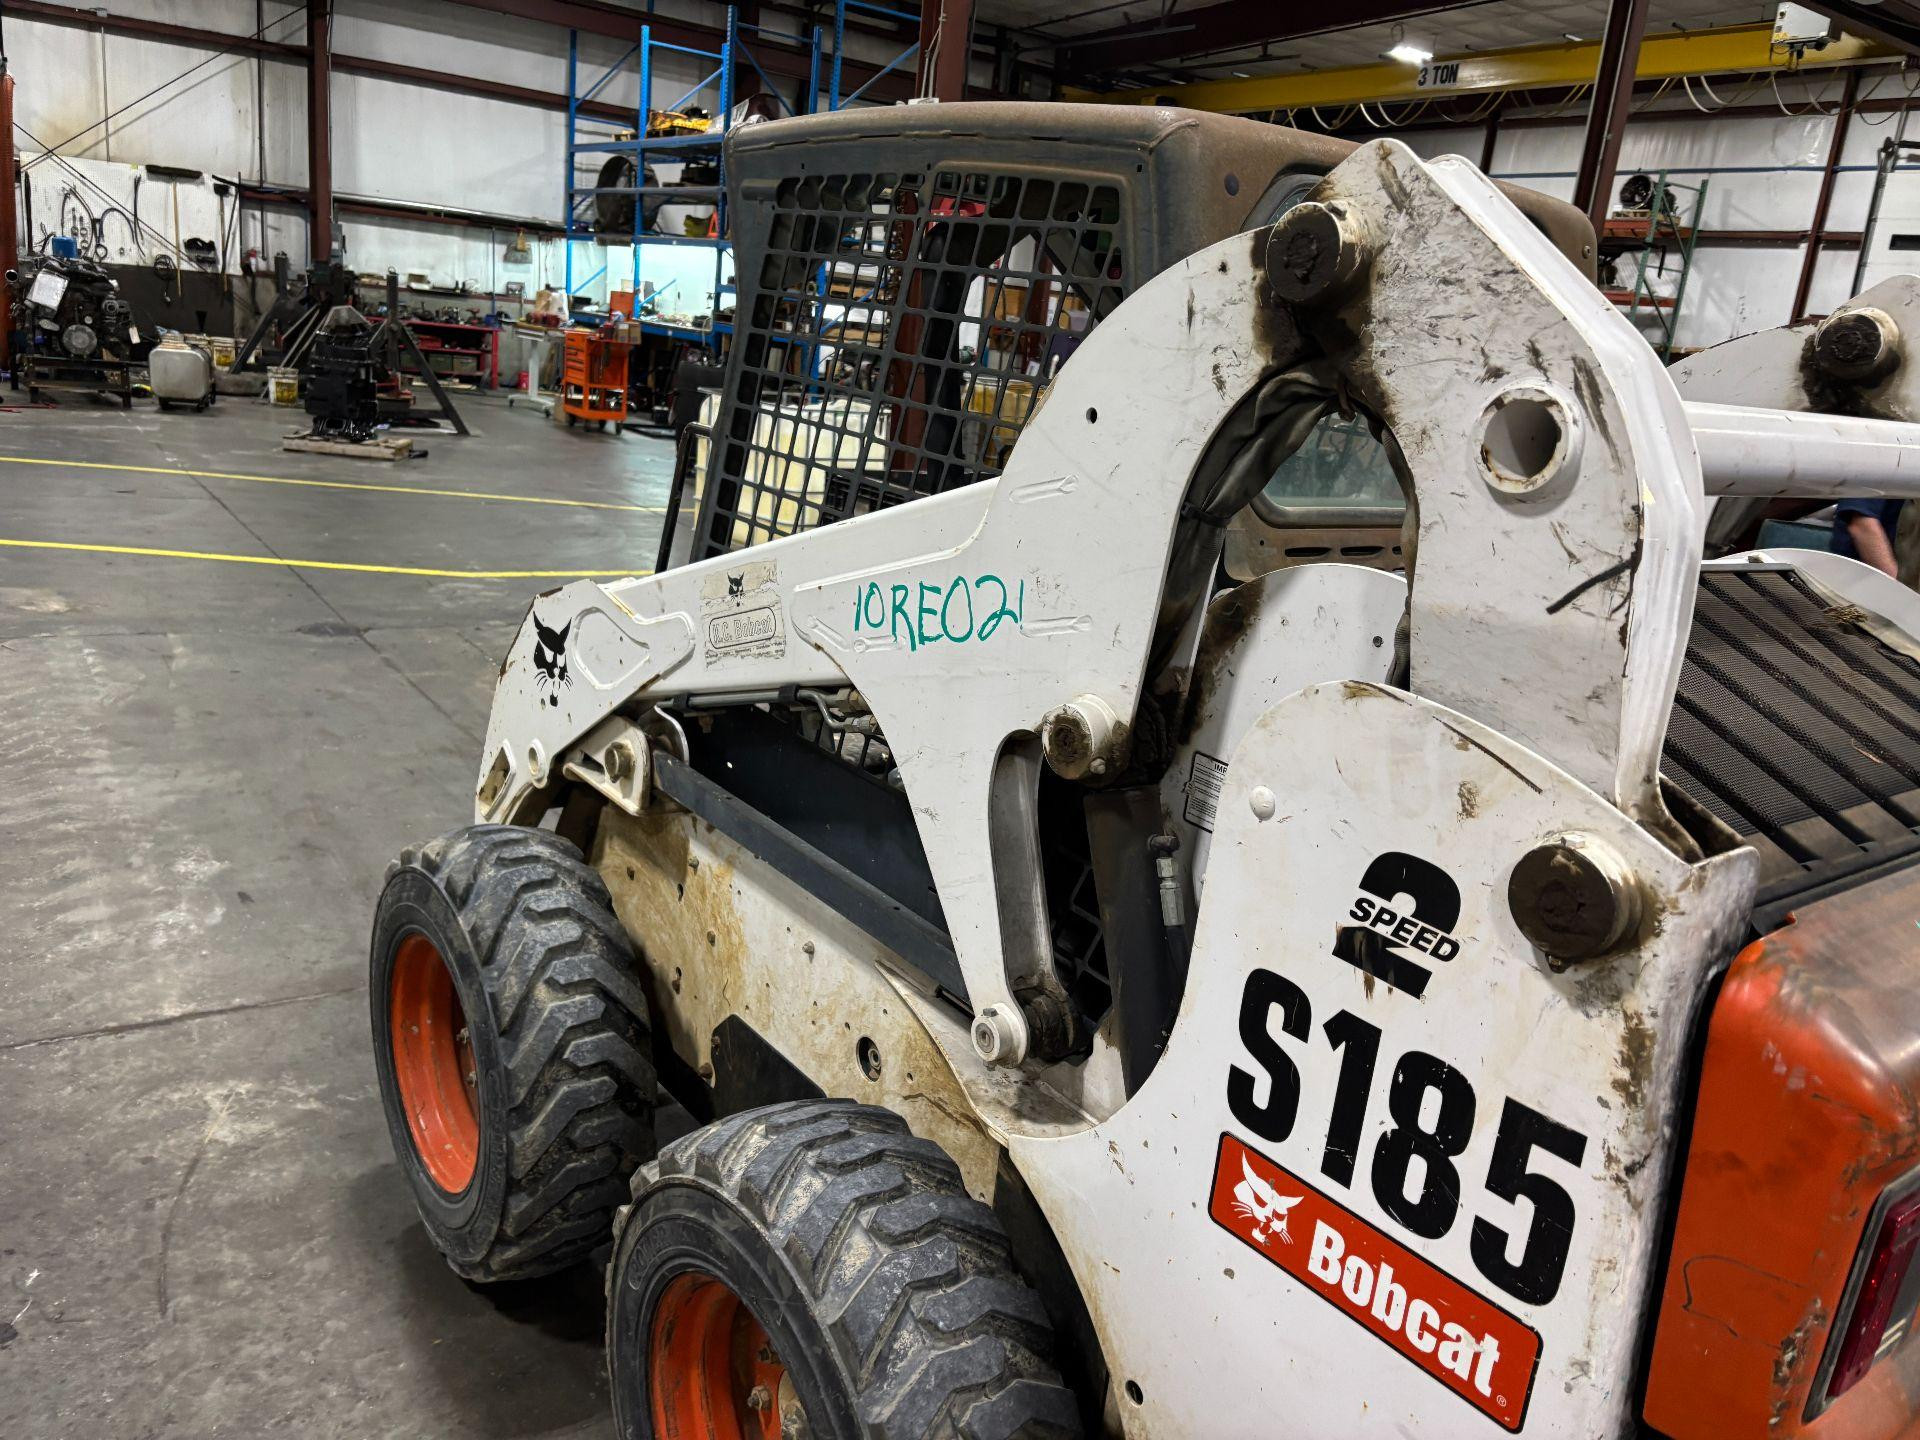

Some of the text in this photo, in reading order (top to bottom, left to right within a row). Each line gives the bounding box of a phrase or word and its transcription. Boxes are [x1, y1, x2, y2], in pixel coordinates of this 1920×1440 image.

[1418, 64, 1460, 86] 3 TON
[1332, 851, 1461, 1000] 2
[1350, 897, 1460, 962] SPEED
[1227, 968, 1588, 1306] S185
[1307, 1218, 1500, 1397] Bobcat
